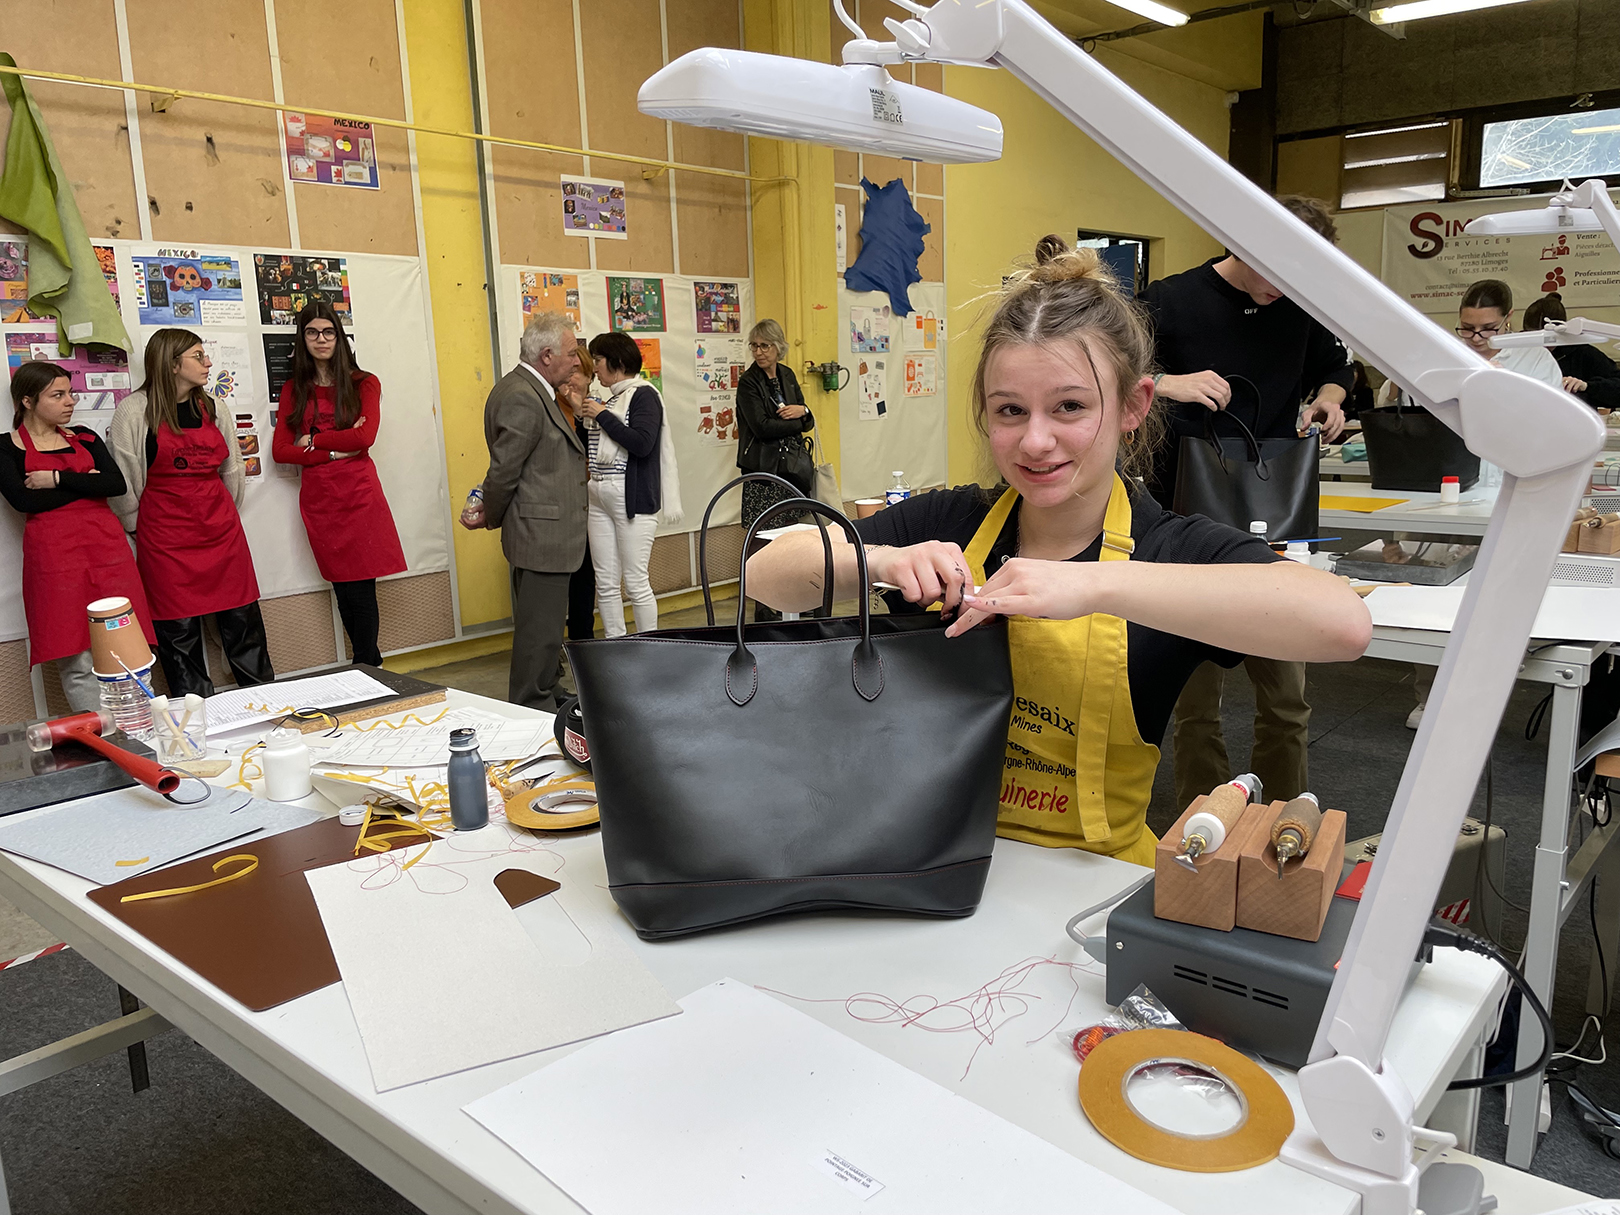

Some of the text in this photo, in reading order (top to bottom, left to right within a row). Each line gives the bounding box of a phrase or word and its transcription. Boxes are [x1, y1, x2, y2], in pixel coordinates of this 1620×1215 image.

[333, 118, 370, 130] MEXICO
[157, 248, 198, 258] MEXICO
[1456, 252, 1480, 260] Berthie
[1481, 250, 1509, 259] Albrecht
[1574, 250, 1600, 258] Aiguilles
[1481, 258, 1509, 266] Limoges
[1574, 269, 1620, 277] Professionne
[1425, 282, 1472, 291] contact@sima
[1581, 278, 1620, 286] Particulier
[1410, 290, 1466, 299] www.simac-se
[1016, 696, 1076, 737] esaix
[1010, 715, 1043, 734] Mines
[1003, 755, 1077, 779] rgne-Rhône-Alpe
[1000, 777, 1069, 813] uinerie
